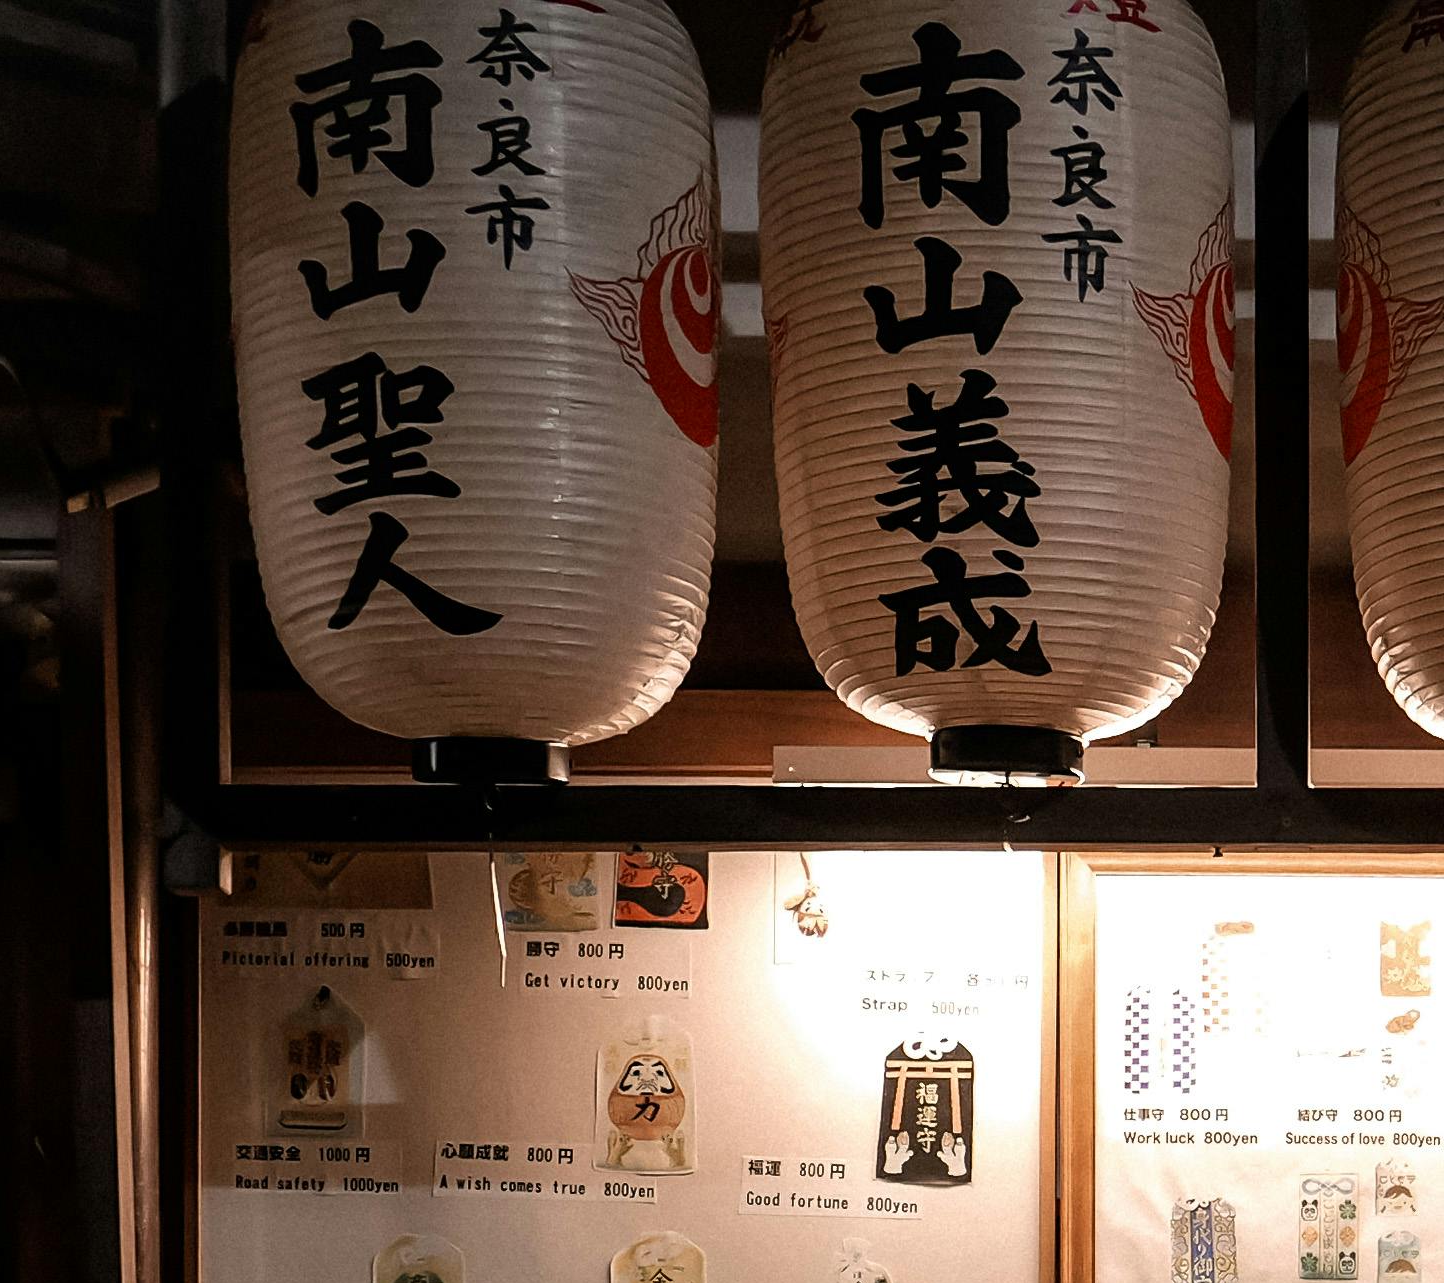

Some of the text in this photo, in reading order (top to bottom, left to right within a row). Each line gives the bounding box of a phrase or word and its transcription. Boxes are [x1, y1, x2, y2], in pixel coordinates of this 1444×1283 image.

[463, 11, 551, 270] 奈良市
[1040, 31, 1123, 302] 奈良市
[289, 22, 505, 636] 南山聖人
[853, 25, 1053, 677] 南山義成
[525, 974, 689, 992] Get victory 800yen
[1124, 1108, 1164, 1122] 仕事守
[1297, 1109, 1337, 1122] 結び守
[1124, 1132, 1258, 1147] Work luck 800yen
[1286, 1133, 1440, 1147] Success of love 800yen
[236, 1144, 301, 1161] 交通安全
[748, 1160, 781, 1177] 福運
[236, 1175, 399, 1193] Road safety 1000yen
[440, 1175, 654, 1199] A wish comes true 800yen
[746, 1191, 917, 1214] Good fortune 800yen
